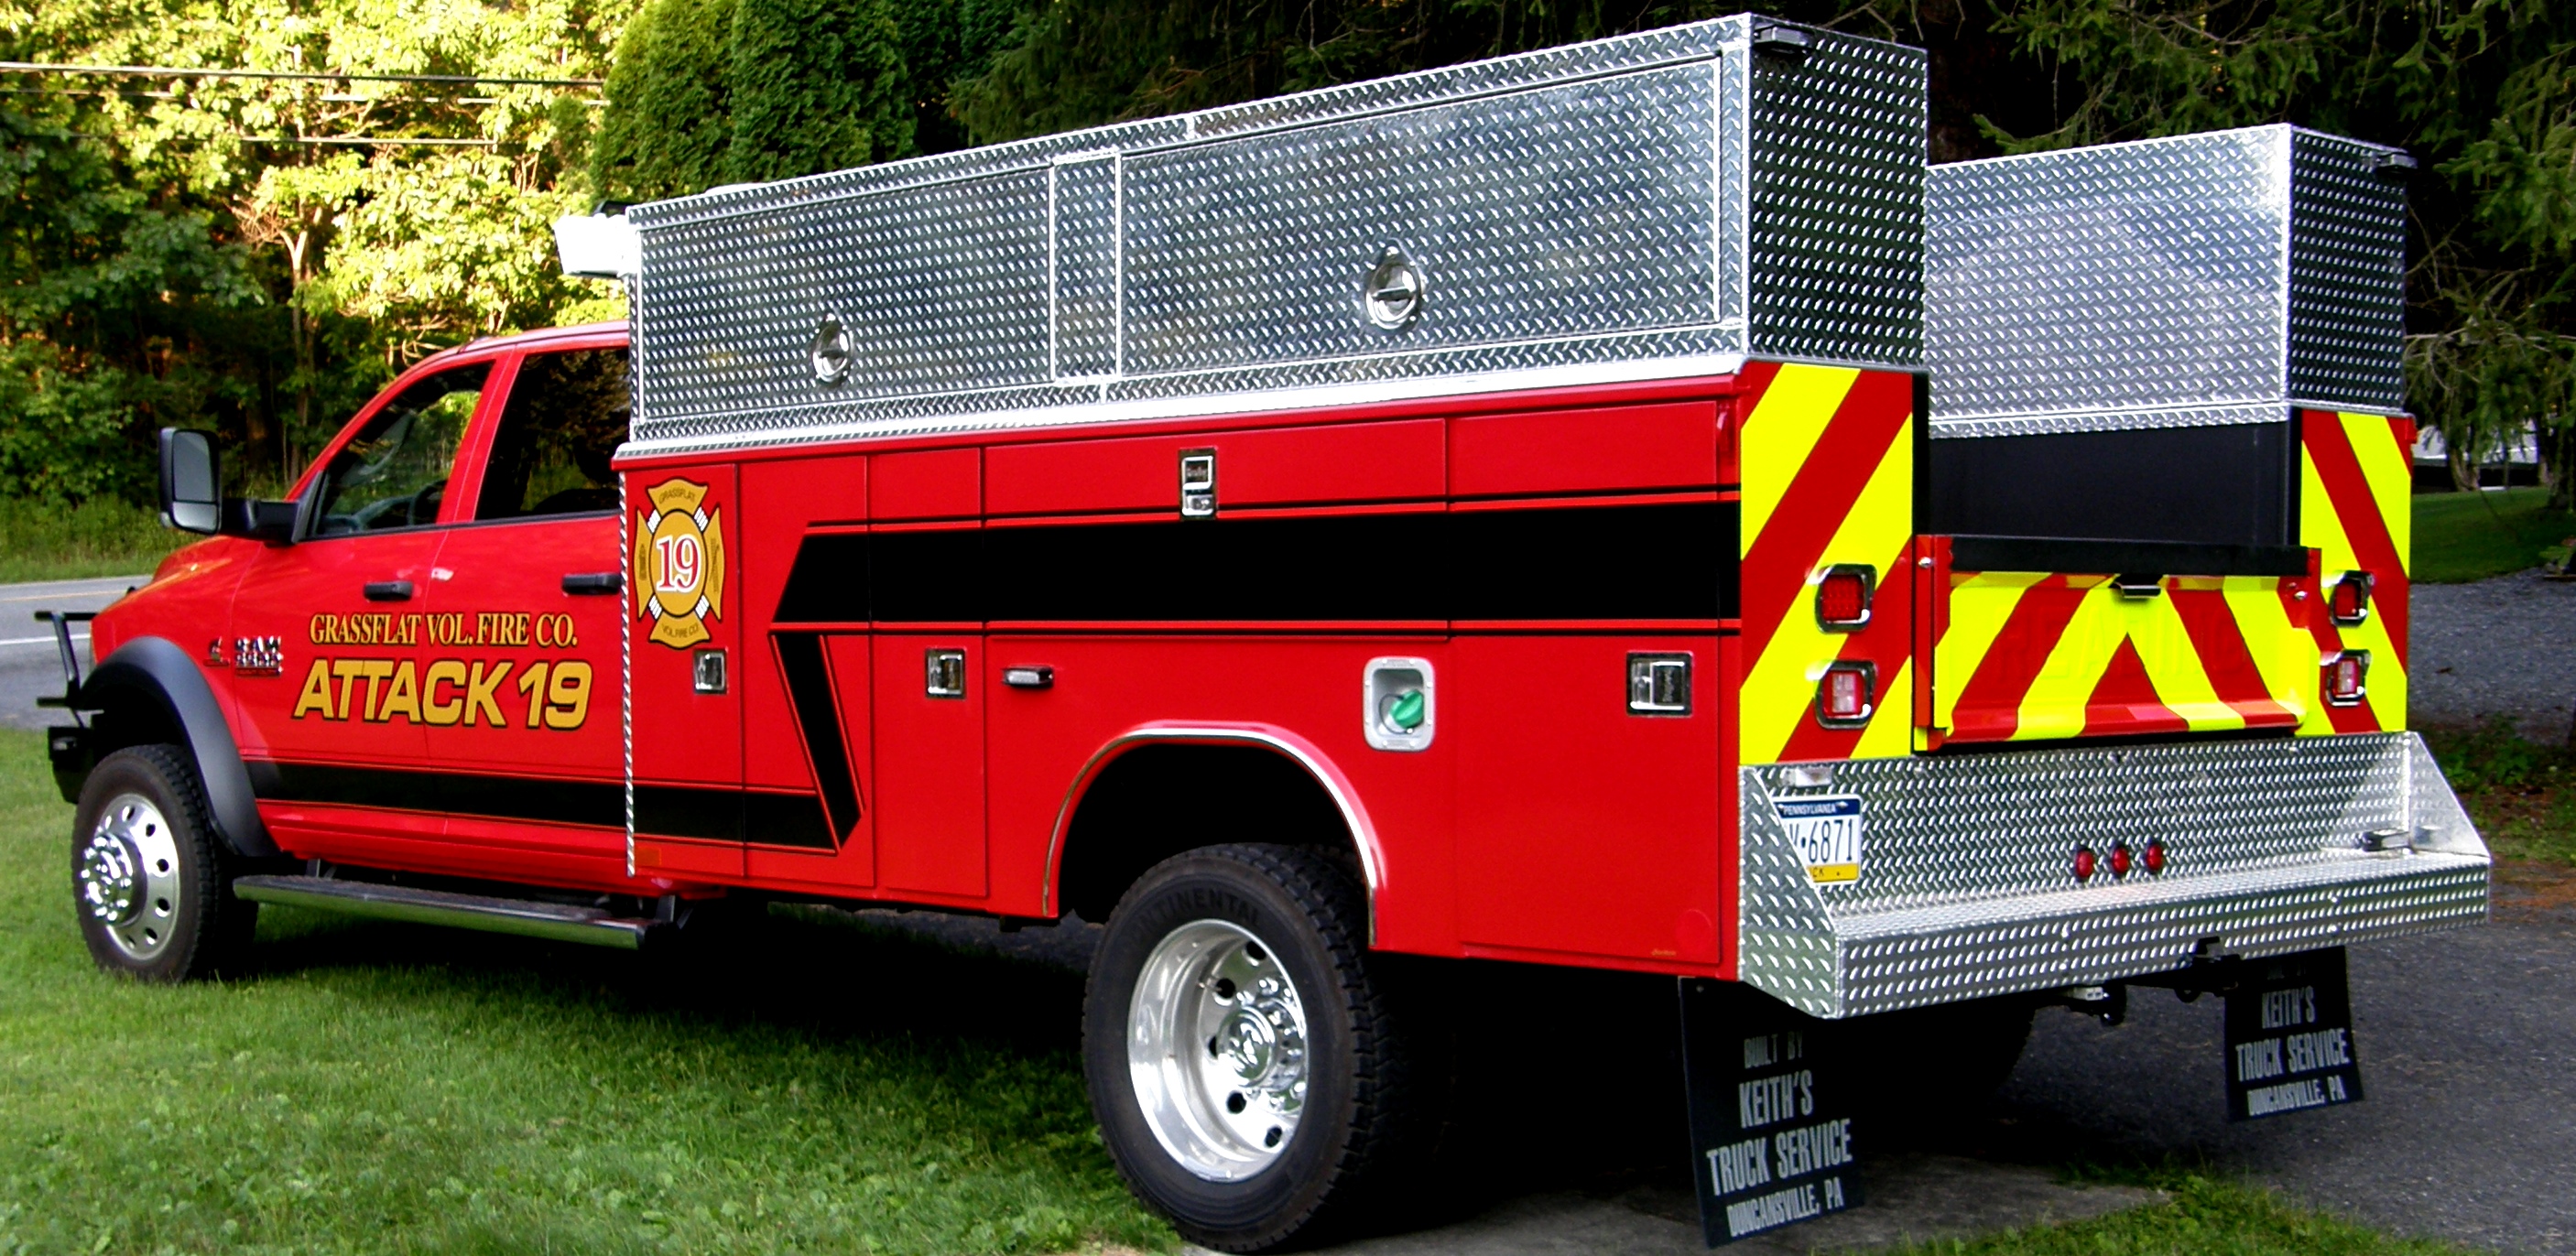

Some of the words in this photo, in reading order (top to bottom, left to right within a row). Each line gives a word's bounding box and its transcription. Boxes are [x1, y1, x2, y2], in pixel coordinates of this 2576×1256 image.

[656, 534, 701, 593] 19
[310, 612, 421, 645] GRASSFLAT
[476, 614, 529, 646] FIRE
[535, 614, 579, 647] CO.
[1994, 601, 2247, 681] READING
[292, 658, 514, 726] ATTACK
[517, 661, 593, 729] 19
[1783, 804, 1837, 816] PENNSYLVANIA
[2261, 985, 2316, 1029] KEITH'S
[2235, 1037, 2284, 1082] TRUCK
[2287, 1027, 2352, 1074] SERVICE
[1739, 1069, 1813, 1129] KEITH'S
[2327, 1074, 2347, 1101] PA
[1706, 1136, 1772, 1196] TRUCK
[1775, 1118, 1853, 1179] SERVICE
[1824, 1176, 1845, 1210] PA
